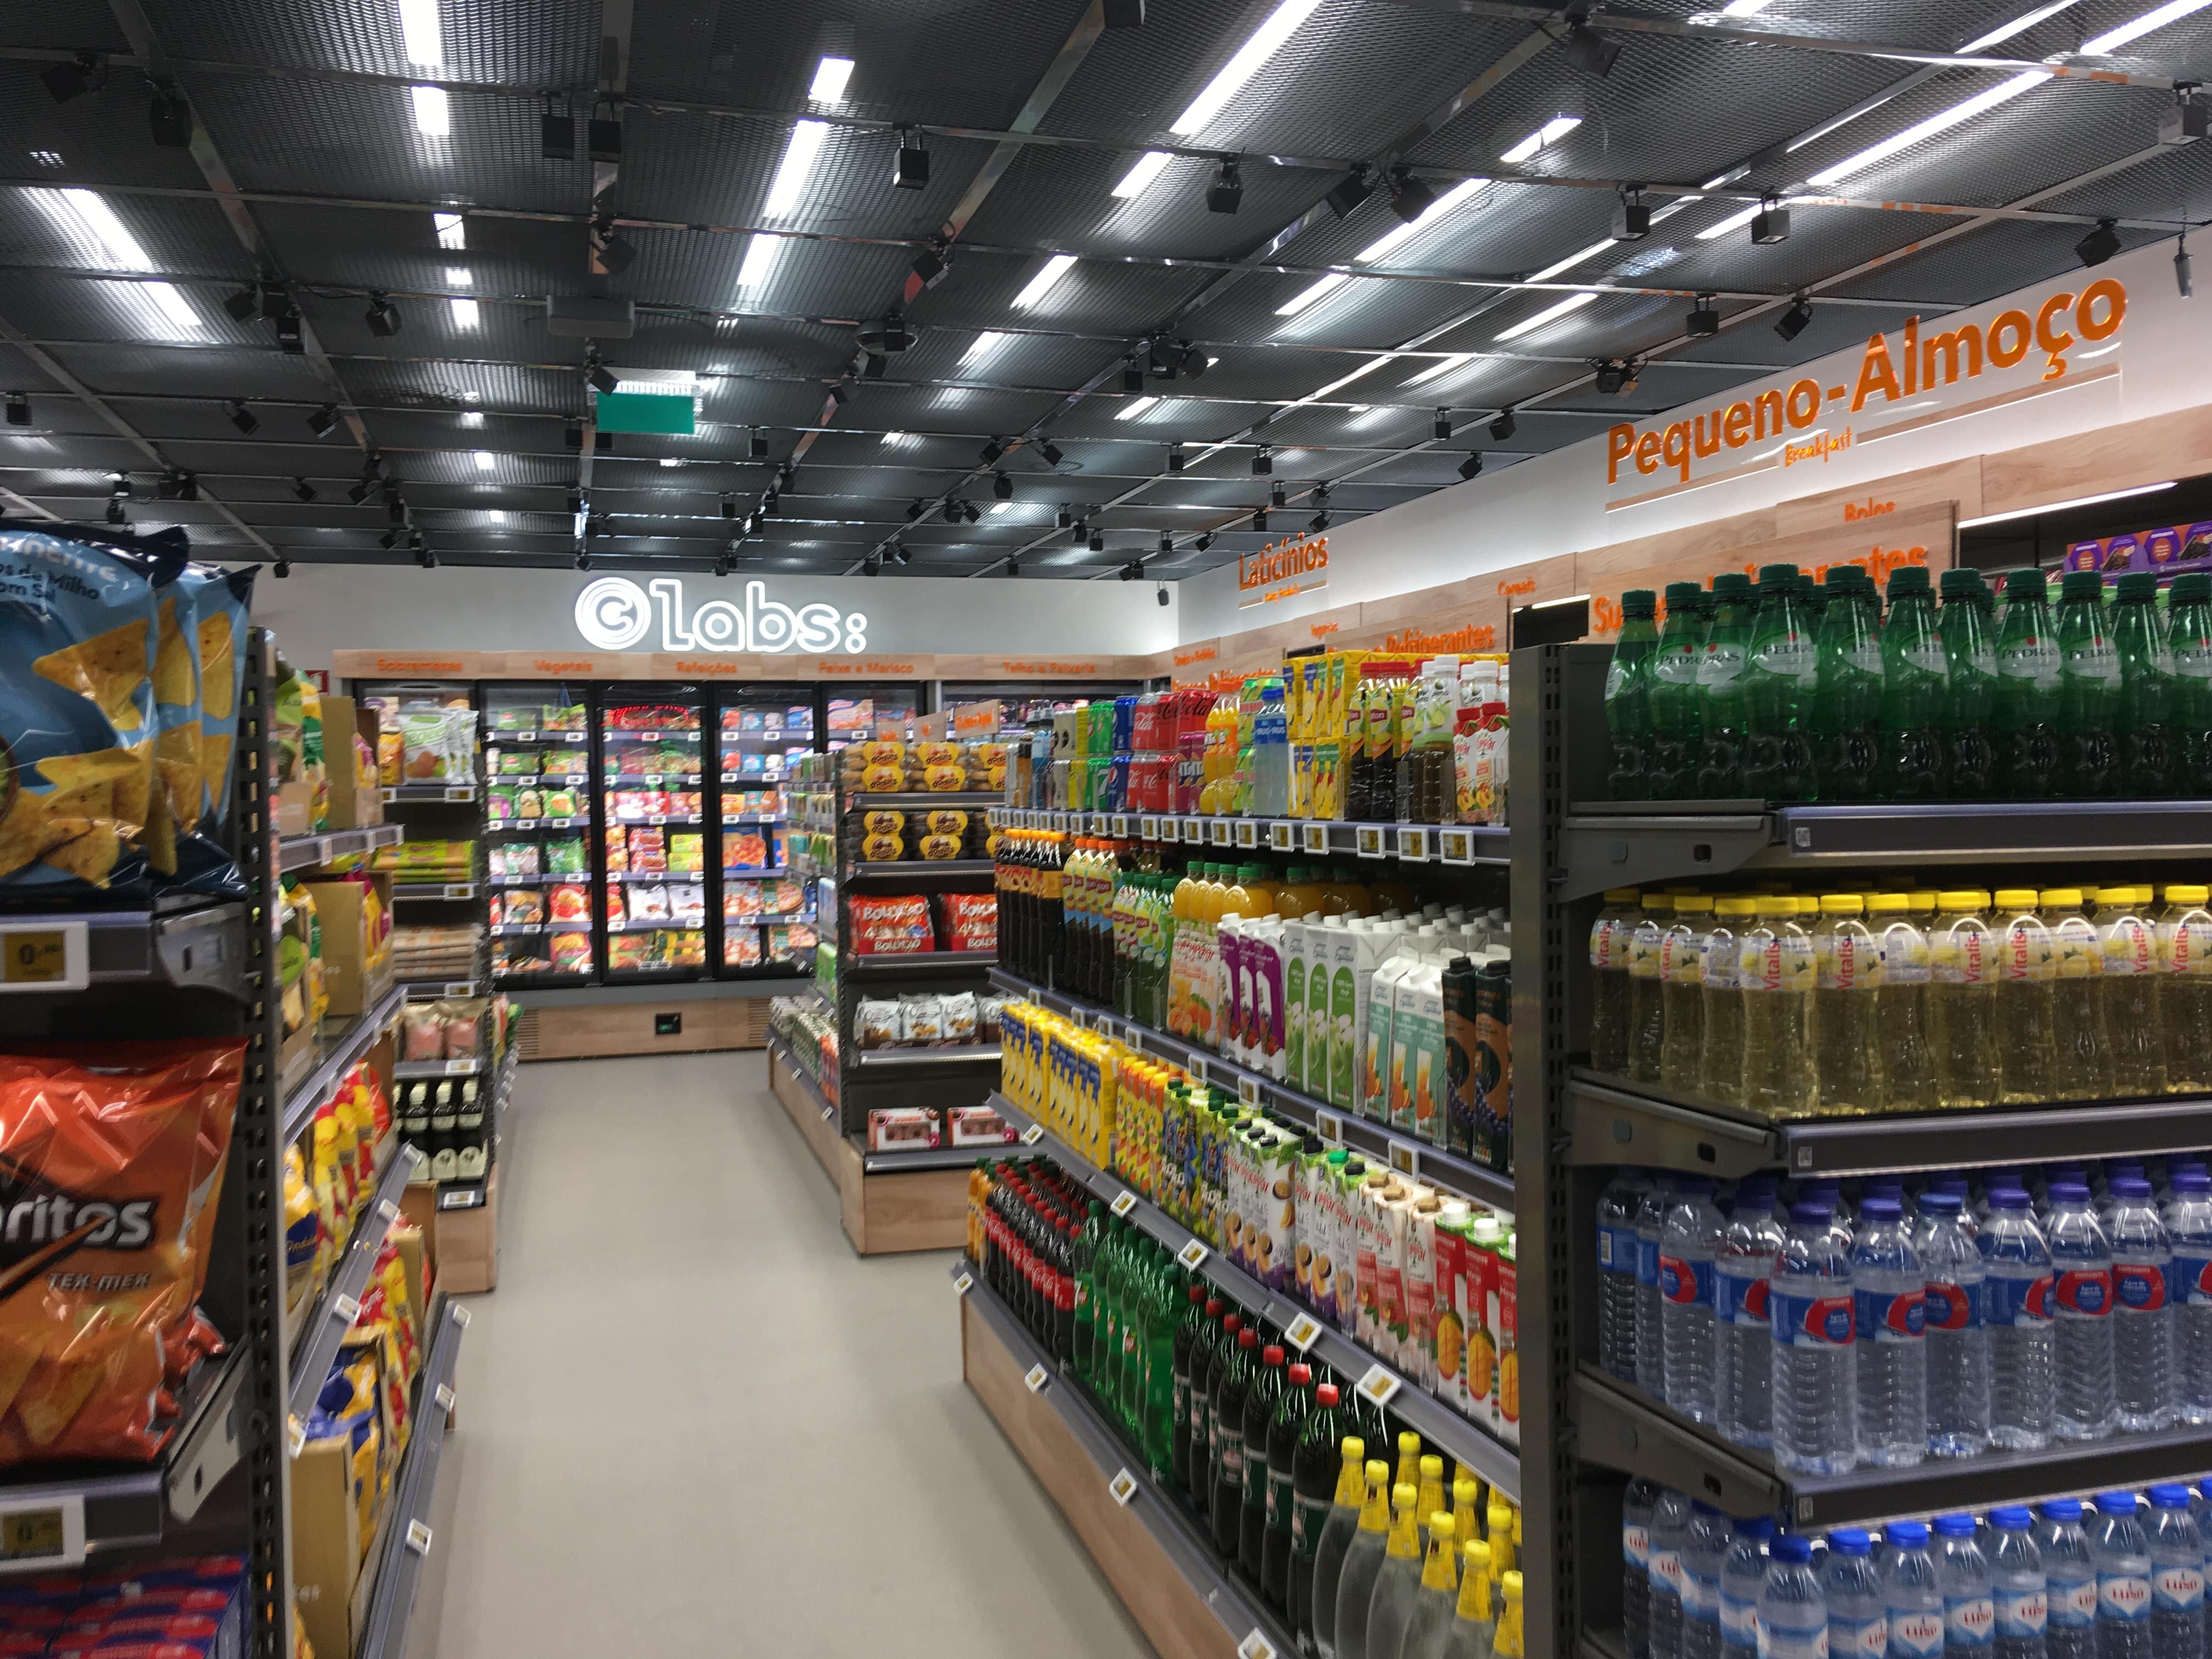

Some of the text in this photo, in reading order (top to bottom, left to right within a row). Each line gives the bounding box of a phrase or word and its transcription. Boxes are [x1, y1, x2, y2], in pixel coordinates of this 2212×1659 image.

[1607, 278, 2127, 486] Pequeno-Almoço
[1785, 426, 1852, 467] Breakfast
[1239, 532, 1329, 592] Laticínios
[377, 658, 463, 672] Sobremesas
[534, 659, 593, 675] Vegetais
[676, 661, 737, 676] Refeições
[819, 662, 914, 674] Peixe e Marisco
[1003, 663, 1034, 673] Talho
[1049, 663, 1096, 674] Peixaria
[1762, 941, 1781, 992] Vitalis
[1834, 941, 1854, 990] Vitalis
[1962, 936, 1982, 983] Vitalis
[2009, 933, 2028, 980] Vitalis
[2130, 927, 2148, 973] Vitalis
[2170, 928, 2190, 974] Vitalis
[0, 1194, 153, 1247] ritos
[48, 1272, 151, 1291] TEX-MEX
